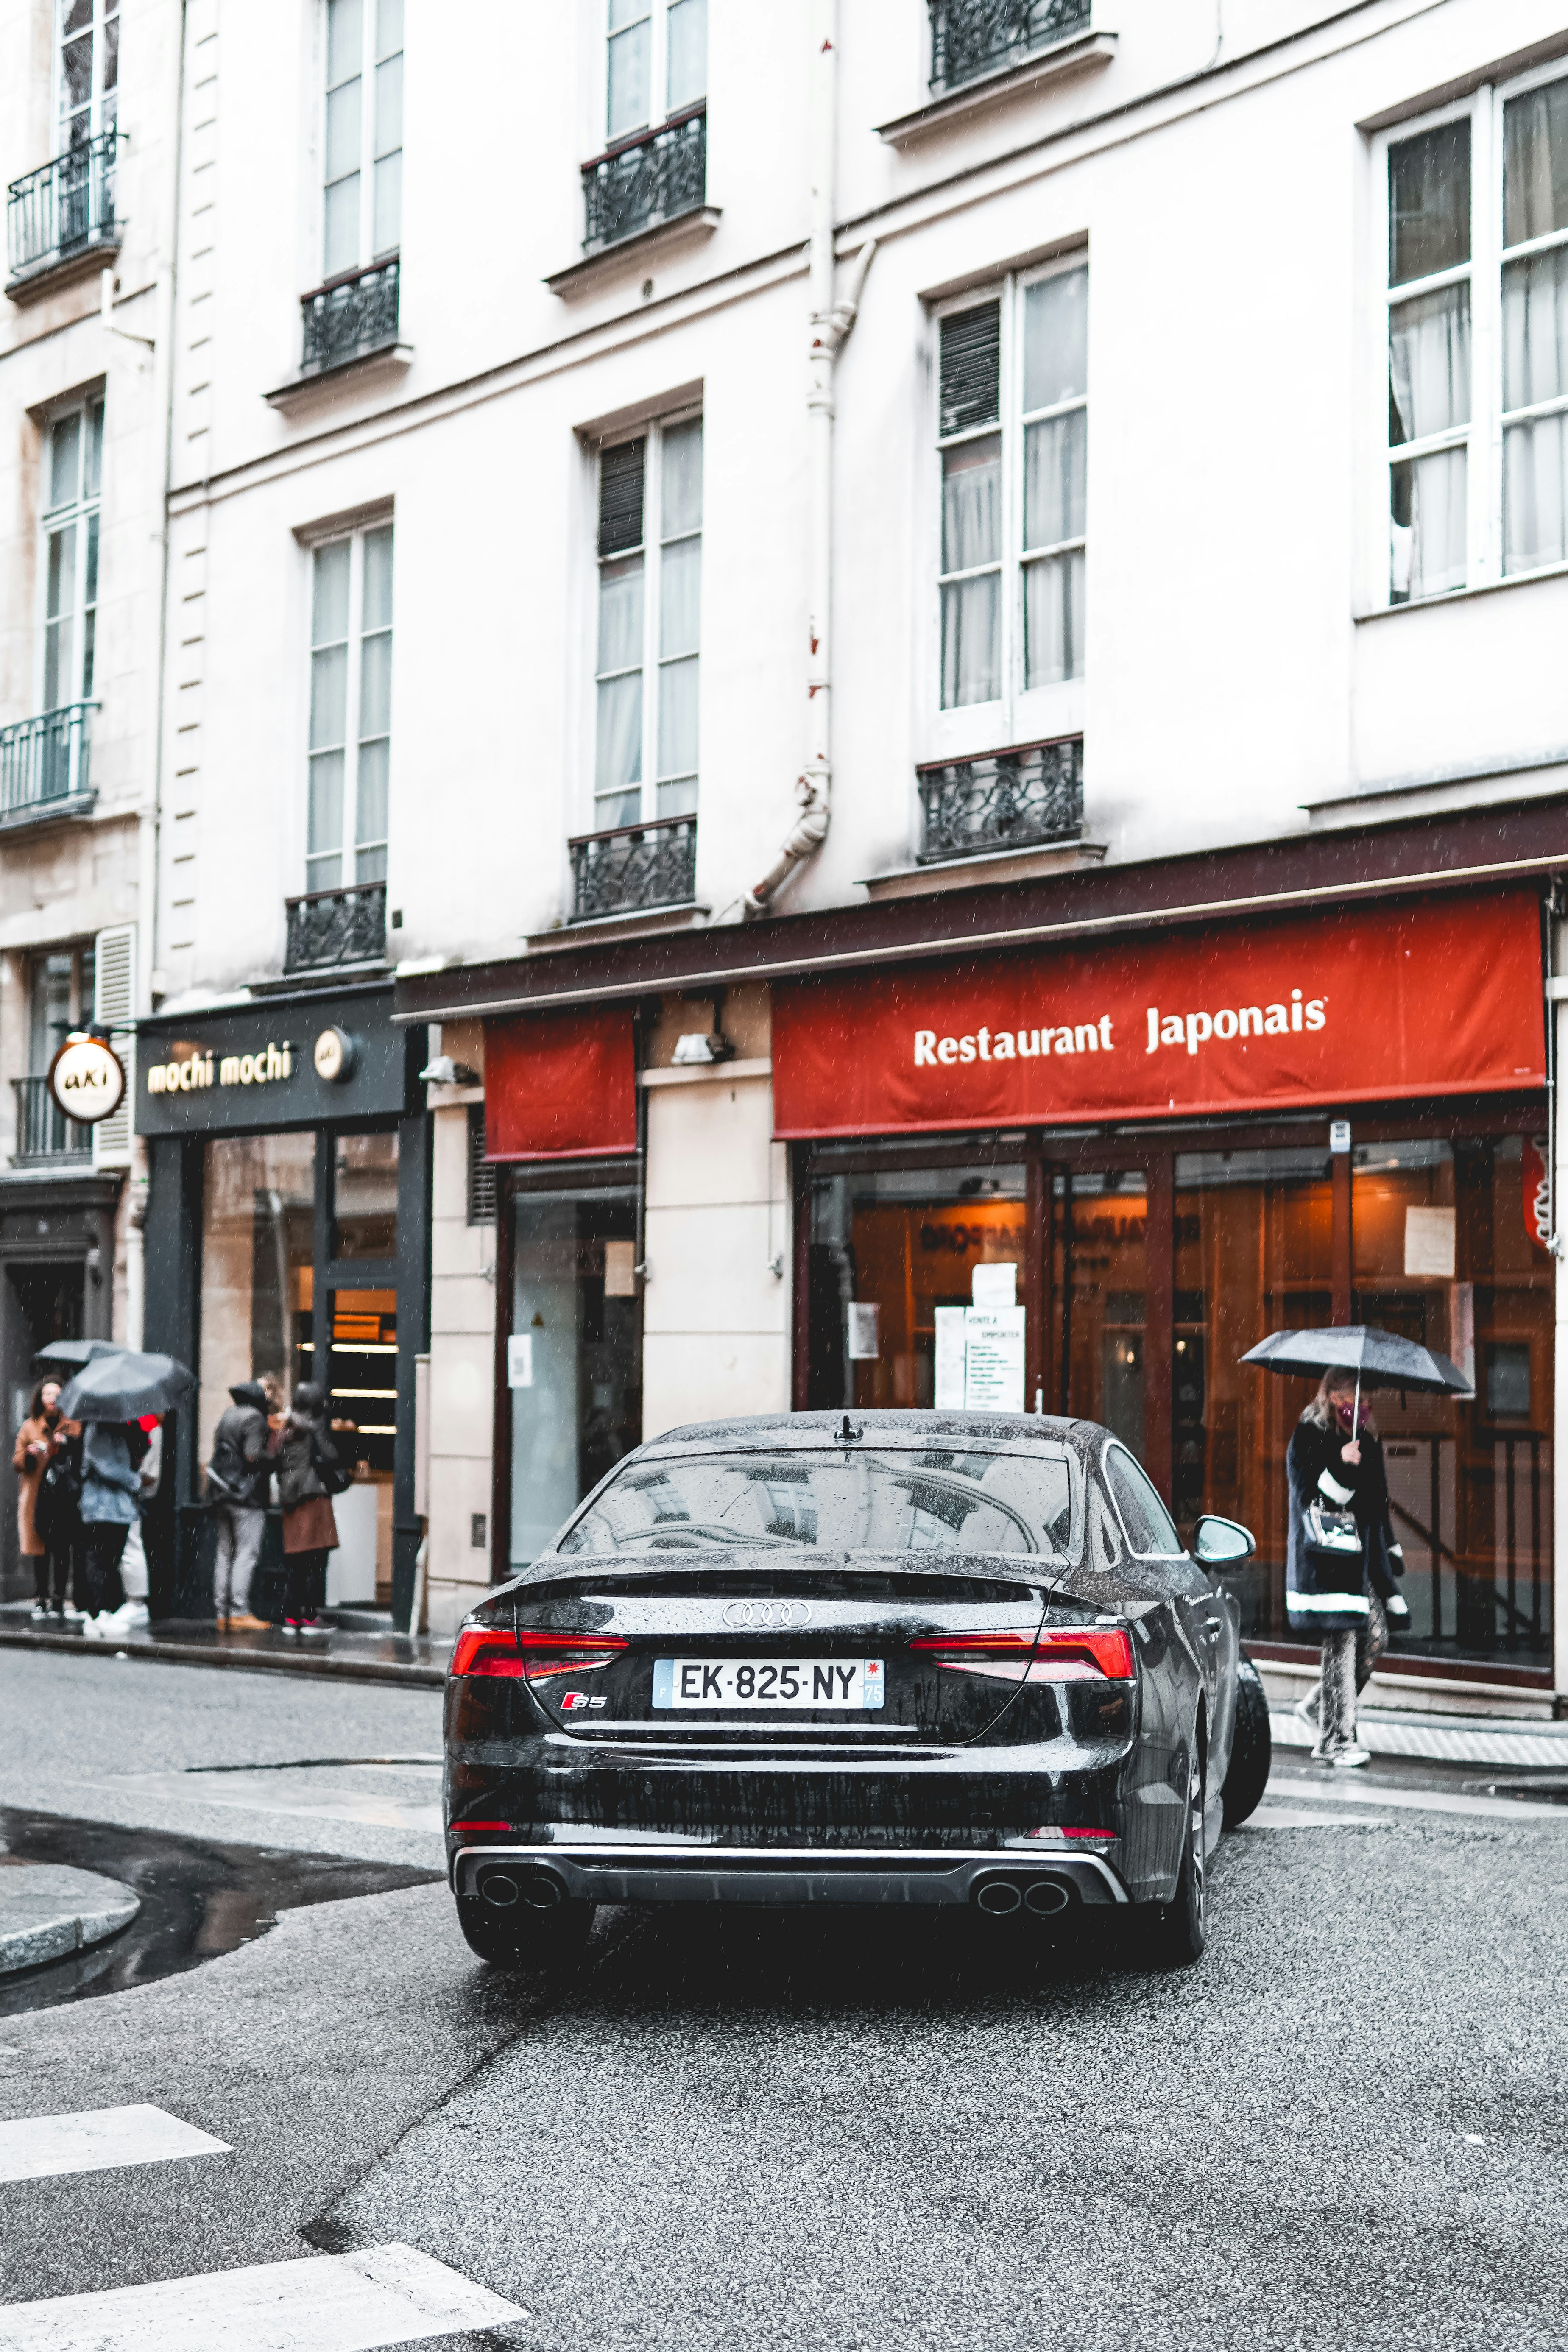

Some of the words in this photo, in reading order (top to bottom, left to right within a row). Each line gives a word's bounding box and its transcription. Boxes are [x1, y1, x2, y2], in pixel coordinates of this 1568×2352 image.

[914, 1015, 1114, 1066] Restaurant
[1145, 988, 1326, 1055] Japonais
[148, 1049, 213, 1093] mochi
[220, 1040, 291, 1086] mochi
[659, 1688, 667, 1699] F
[681, 1665, 856, 1699] EK-825-NY
[865, 1685, 882, 1702] 75
[571, 1696, 607, 1708] S5
